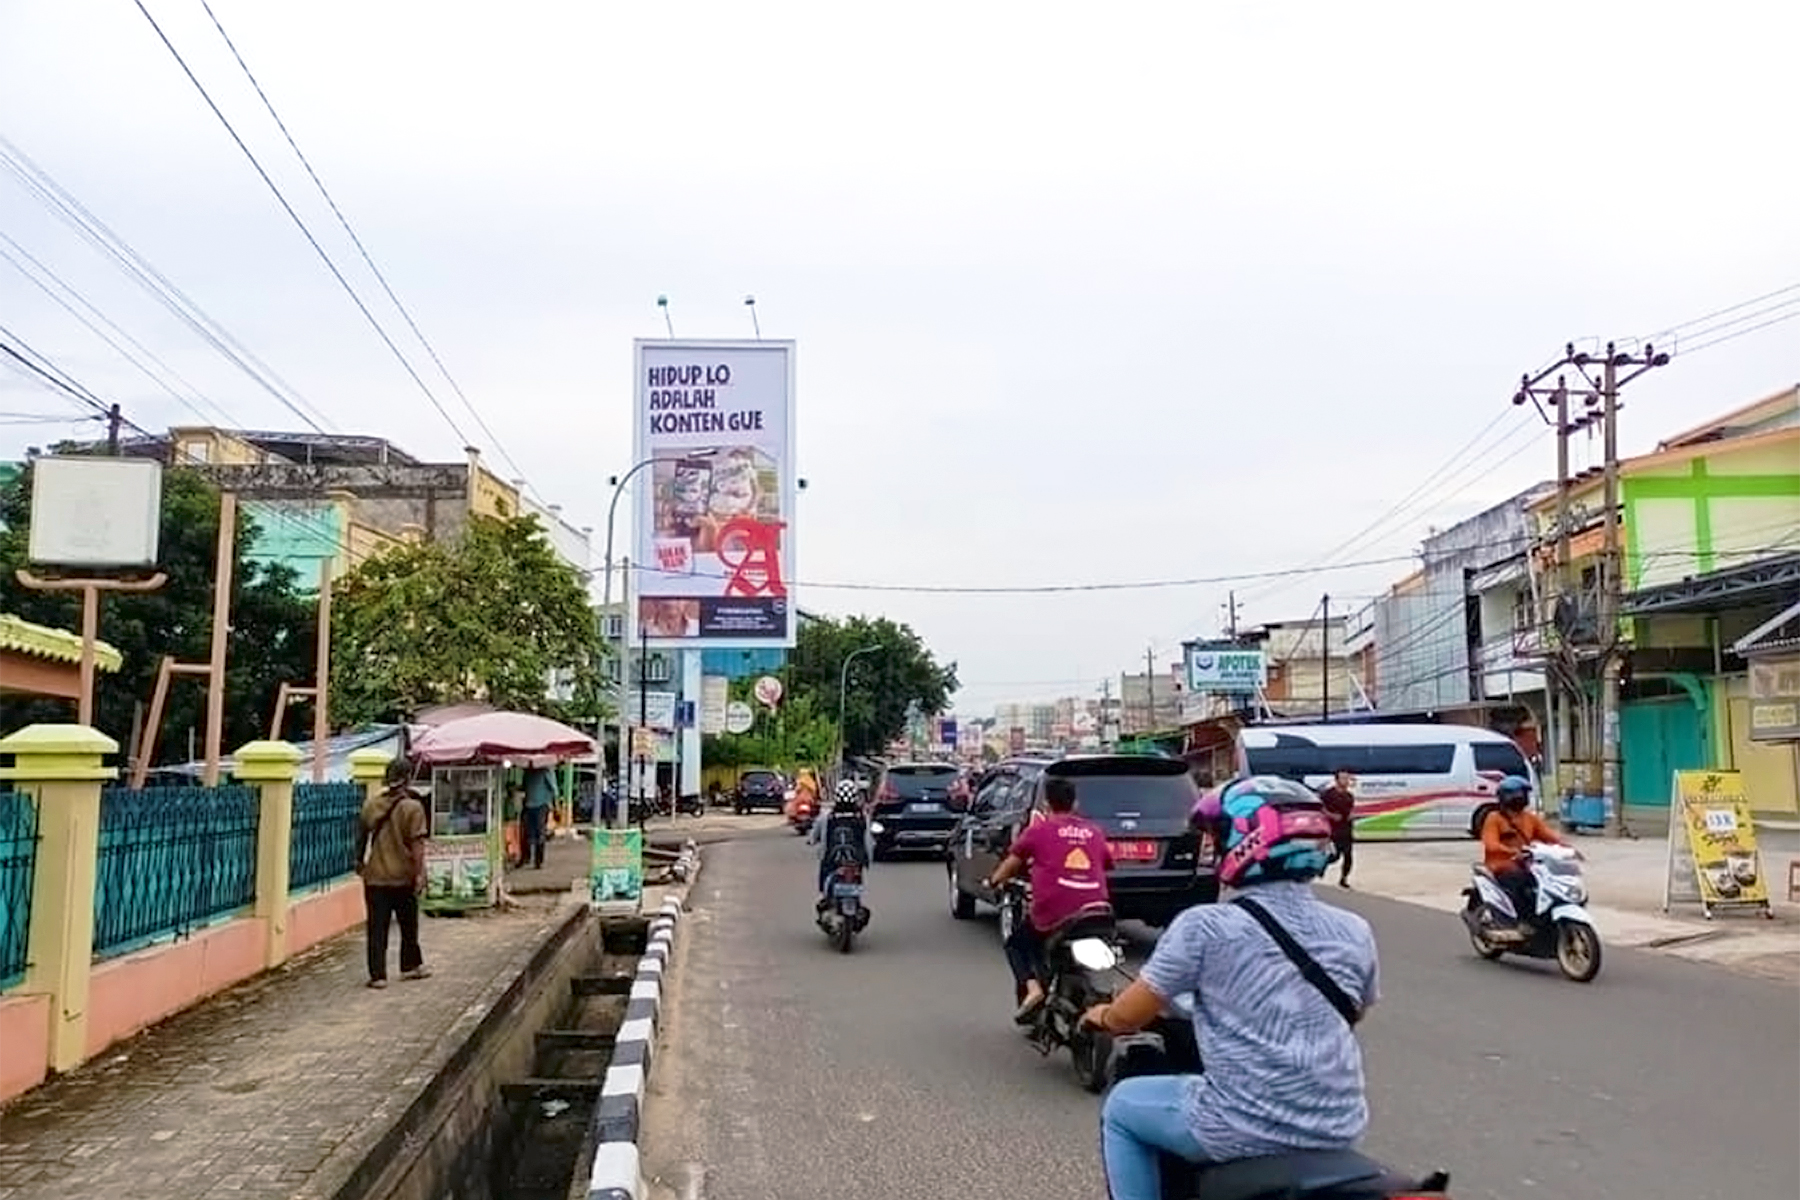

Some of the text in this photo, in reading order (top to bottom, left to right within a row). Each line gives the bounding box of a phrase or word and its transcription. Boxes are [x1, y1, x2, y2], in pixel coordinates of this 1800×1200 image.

[649, 364, 731, 387] HIDUP LO
[650, 389, 716, 410] ADALAH
[650, 410, 763, 434] KONTEN GUE
